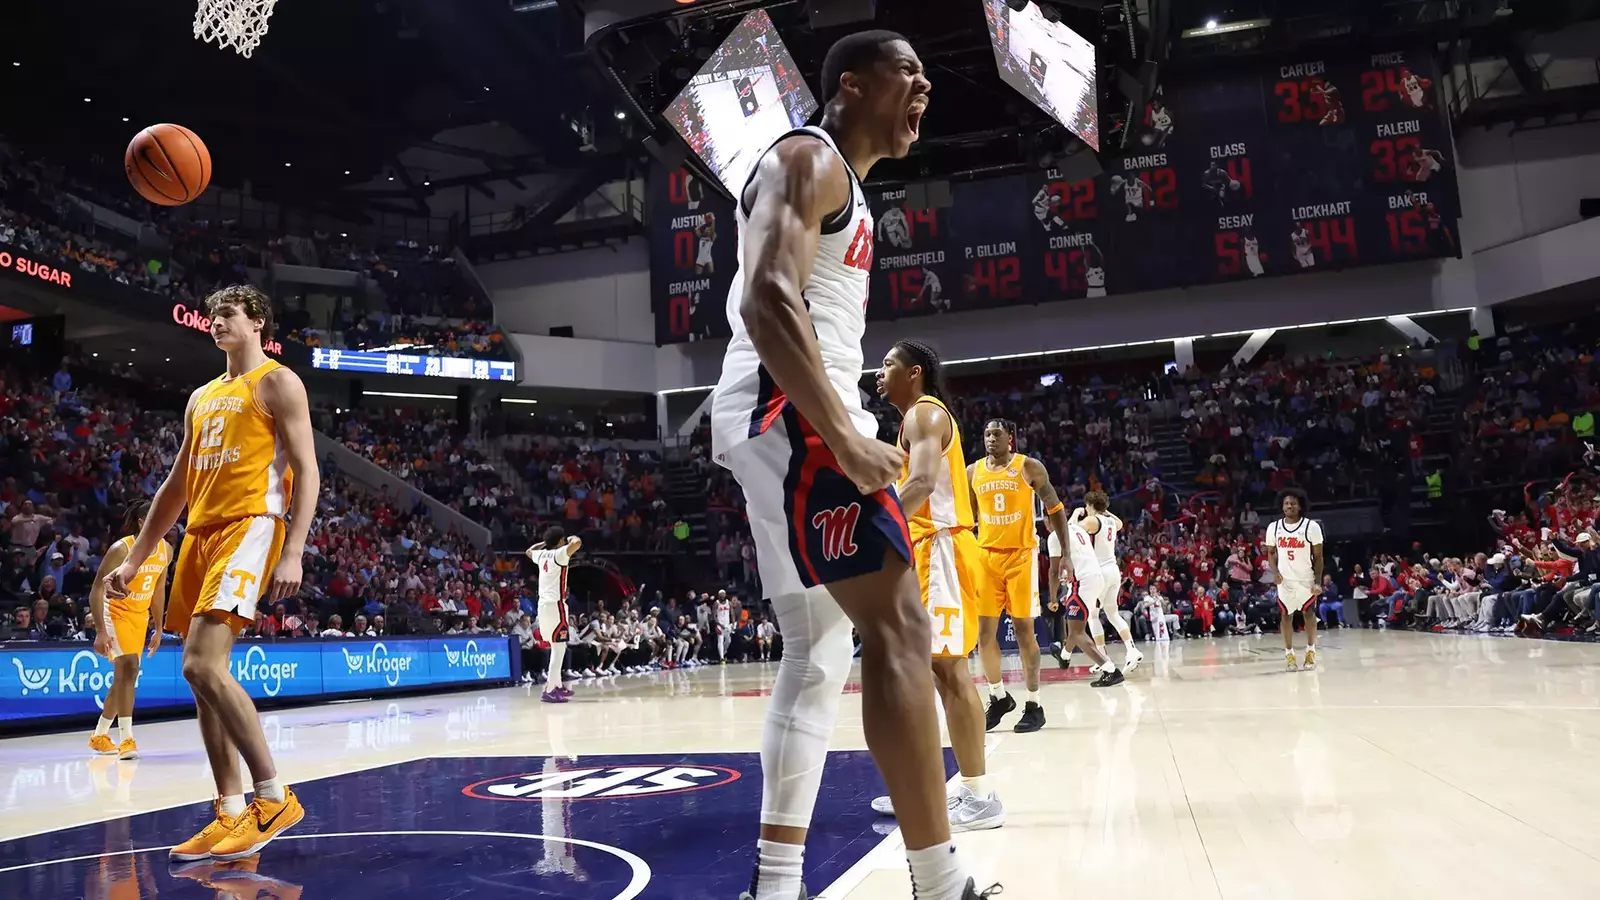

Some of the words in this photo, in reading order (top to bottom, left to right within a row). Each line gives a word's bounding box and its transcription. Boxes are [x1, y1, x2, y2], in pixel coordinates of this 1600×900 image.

[1371, 51, 1404, 67] PRICE
[1280, 61, 1325, 78] CARTER
[1360, 67, 1411, 113] 24
[1274, 77, 1326, 123] 33
[1377, 120, 1420, 137] FALERU
[1210, 143, 1246, 159] GLASS
[1124, 153, 1167, 170] BARNES
[1227, 158, 1252, 198] 4
[1048, 179, 1098, 220] 22
[1388, 192, 1428, 209] BAKER
[1292, 201, 1351, 220] LOCKHART
[671, 214, 706, 230] AUSTIN
[1219, 214, 1254, 229] SESAY
[1050, 233, 1093, 249] CONNER
[1304, 216, 1357, 262] 44
[1385, 210, 1427, 254] 15
[977, 241, 1016, 258] GILLOM
[880, 251, 945, 269] SPRINGFIELD
[16, 257, 71, 288] SUGAR
[973, 257, 1022, 298] 42
[669, 279, 710, 295] GRAHAM
[173, 303, 211, 333] Coke
[200, 416, 225, 449] 12
[978, 480, 1020, 496] TENNESSEE
[994, 493, 1006, 512] 8
[812, 502, 861, 562] M
[1076, 532, 1086, 546] 0
[1107, 527, 1113, 542] 8
[1287, 550, 1295, 561] 5
[543, 559, 549, 573] 4
[142, 575, 153, 591] 2
[231, 569, 256, 600] T
[934, 607, 959, 636] T
[366, 642, 411, 686] Kroger
[462, 640, 497, 679] Kroger
[59, 650, 142, 710] Kror
[237, 646, 298, 697] Kroger
